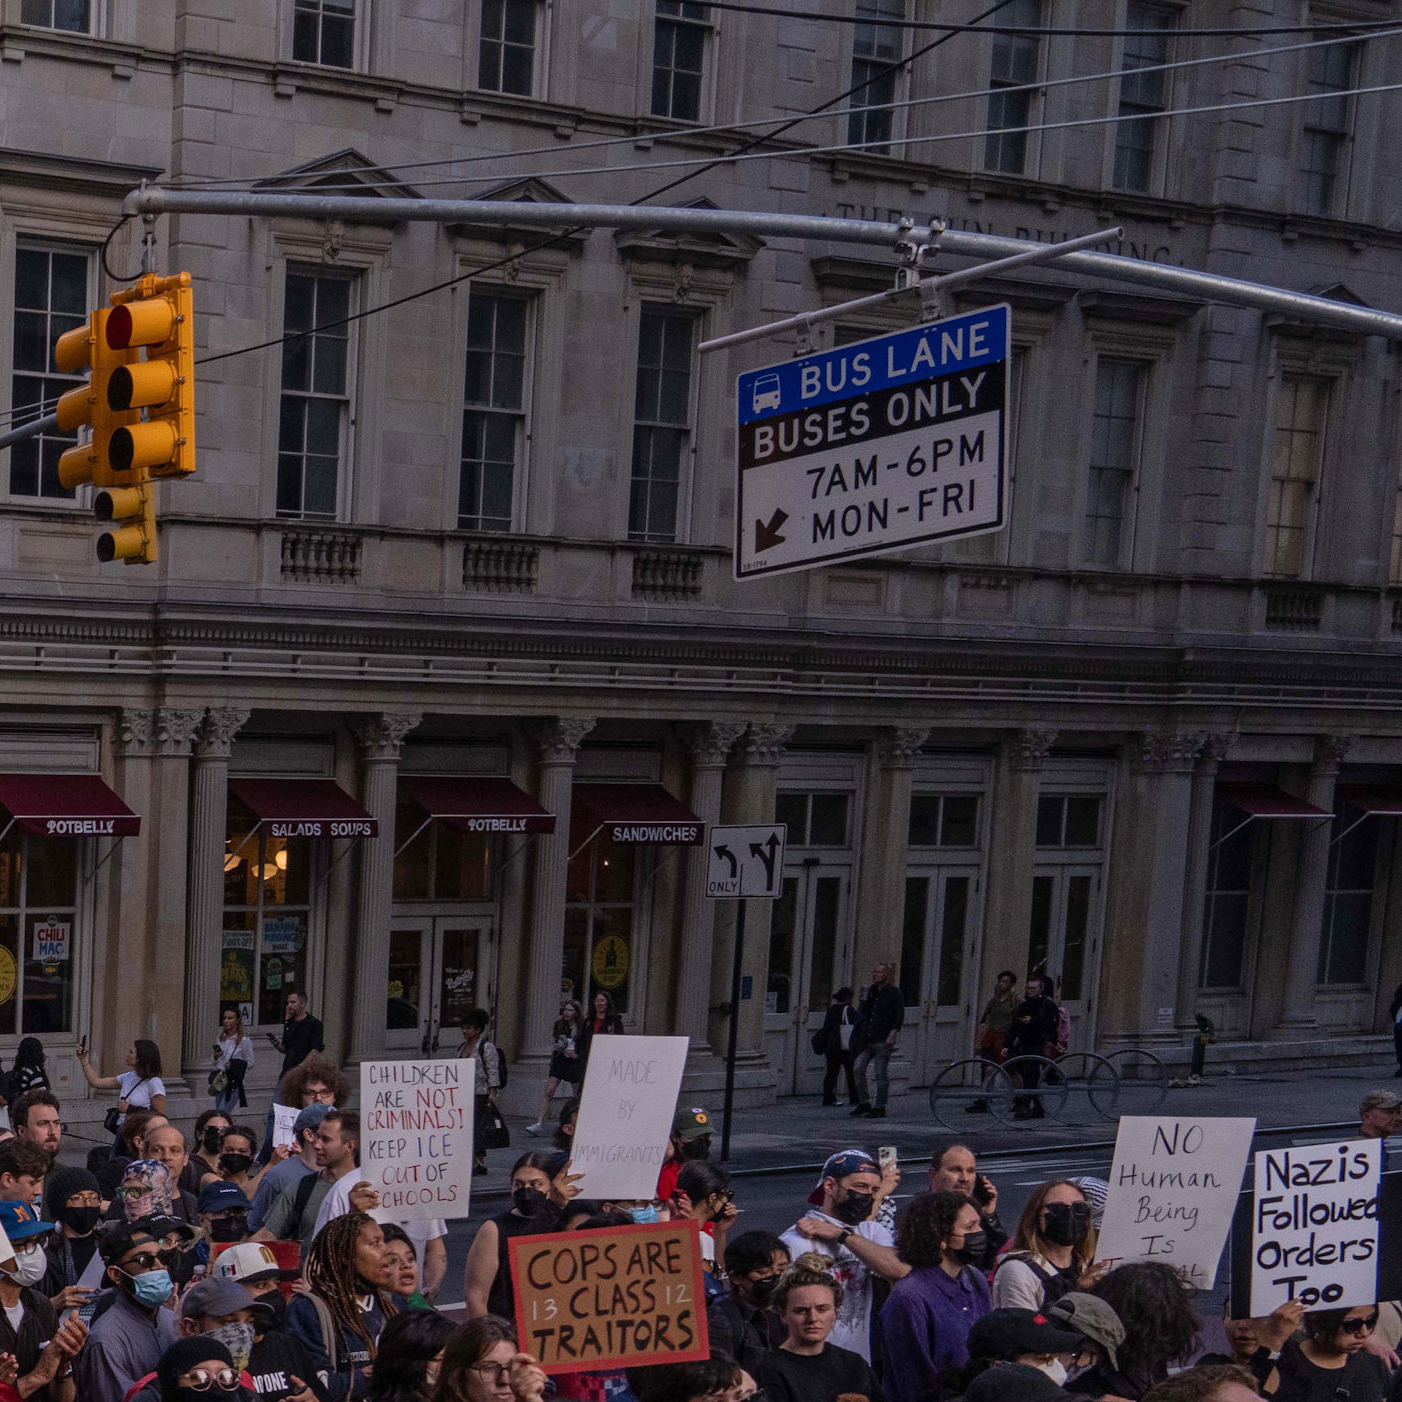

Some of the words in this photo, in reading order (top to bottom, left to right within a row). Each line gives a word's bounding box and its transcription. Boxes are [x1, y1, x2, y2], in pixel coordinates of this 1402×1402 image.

[801, 353, 871, 399] BUS
[887, 321, 990, 378] LANE
[755, 402, 870, 459] BUSES
[887, 372, 986, 426] ONLY
[812, 479, 975, 543] MON-FRI
[47, 819, 114, 835] POTBELLY
[272, 823, 321, 836] SALADS
[331, 822, 371, 836] SOUPS
[468, 818, 528, 832] POTBELLY
[613, 827, 697, 841] SANDWICHES
[37, 928, 64, 942] CHILI
[38, 943, 62, 956] MAC
[369, 1064, 459, 1085] CHILDREN
[608, 1059, 659, 1085] MADE
[374, 1090, 404, 1109] ARE
[416, 1087, 457, 1109] NOT
[617, 1100, 637, 1119] BY
[366, 1107, 464, 1132] CRIMINALS!
[368, 1138, 407, 1160] KEEP
[417, 1134, 453, 1158] ICE
[1152, 1123, 1203, 1155] NO
[574, 1142, 664, 1167] IMMIGRANTS
[382, 1165, 418, 1186] OUT
[426, 1163, 448, 1182] OF
[1119, 1164, 1221, 1189] Human
[1265, 1146, 1370, 1191] Nazis
[381, 1185, 458, 1207] CHOOLS
[1134, 1195, 1199, 1232] Being
[1139, 1235, 1175, 1256] Is
[1256, 1232, 1375, 1270] Orders
[527, 1244, 618, 1290] COPS
[628, 1238, 682, 1277] ARE
[532, 1298, 559, 1320] 13
[569, 1278, 657, 1317] CLASS
[665, 1283, 694, 1306] 12
[1272, 1275, 1343, 1307] Too
[533, 1310, 694, 1362] TRAITORS
